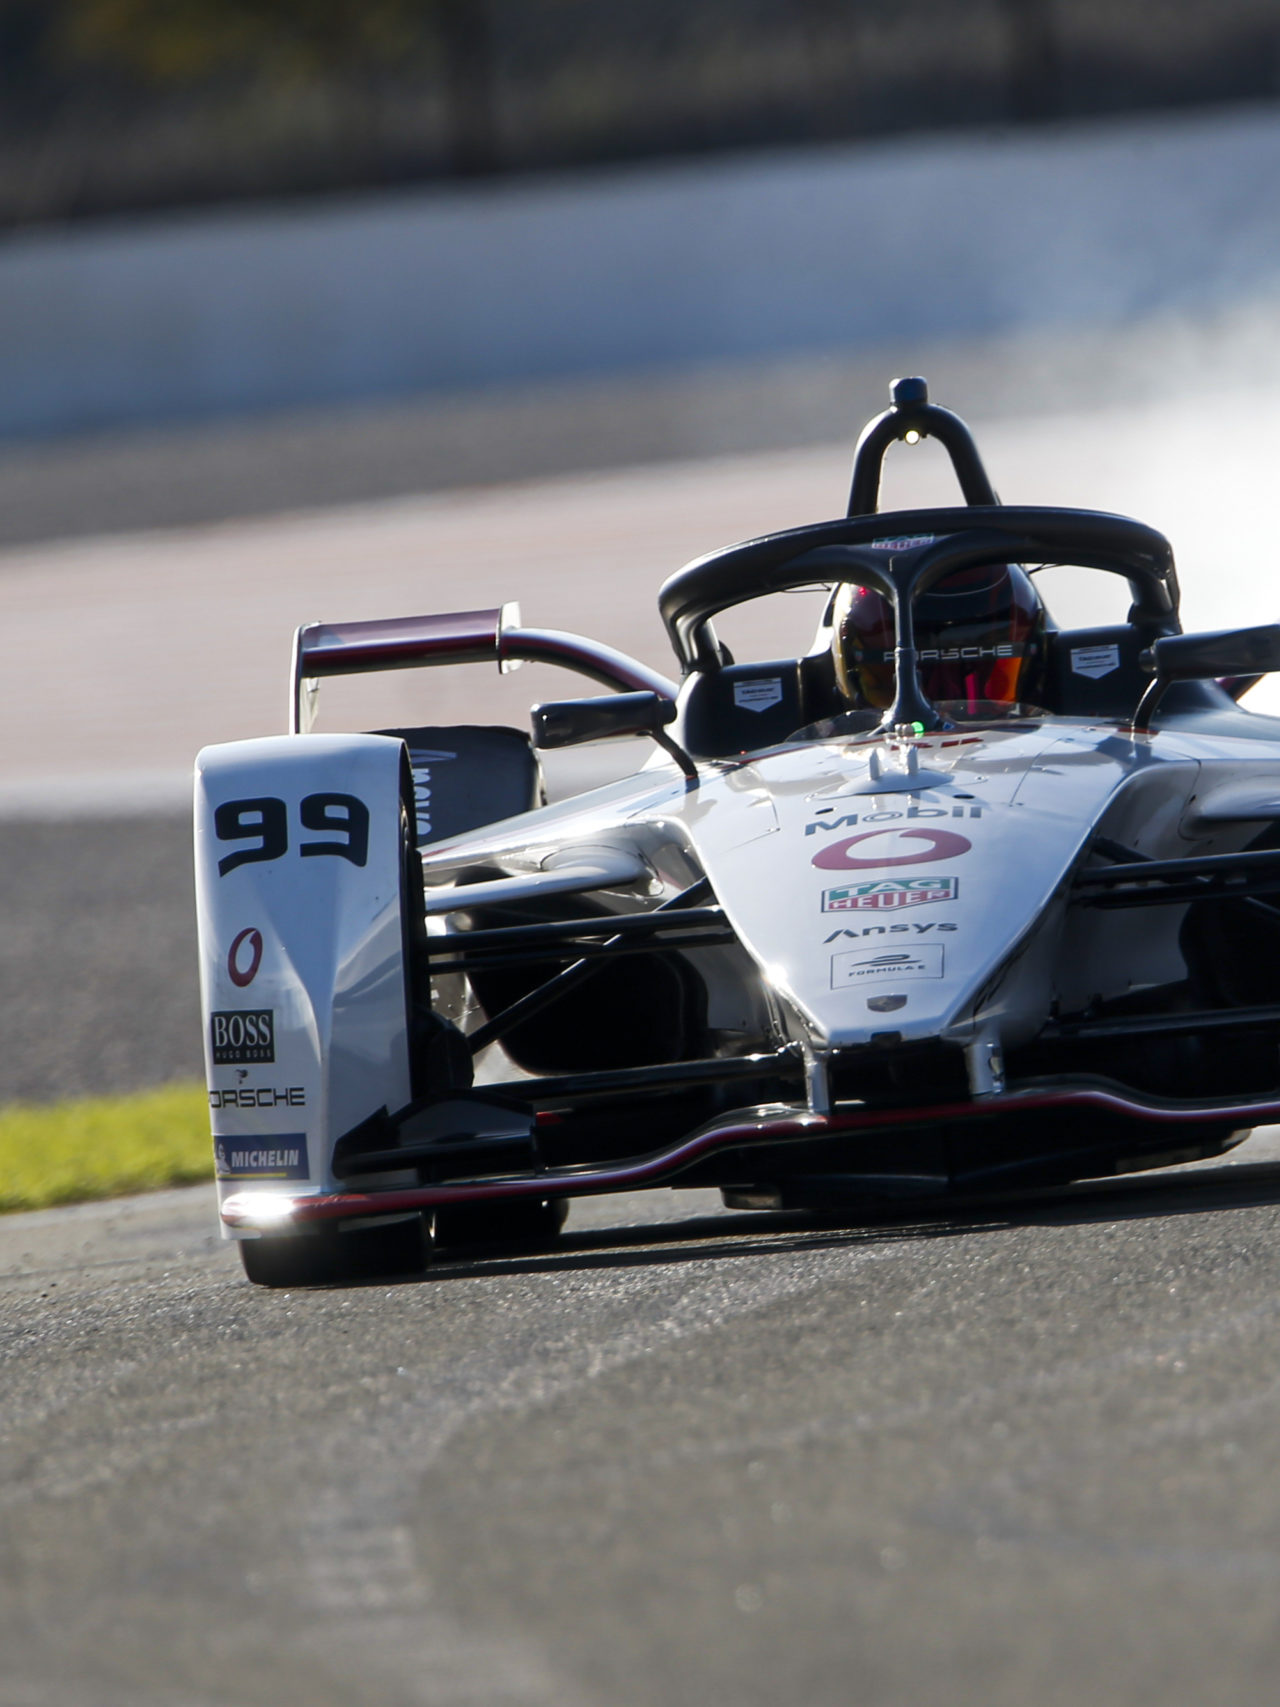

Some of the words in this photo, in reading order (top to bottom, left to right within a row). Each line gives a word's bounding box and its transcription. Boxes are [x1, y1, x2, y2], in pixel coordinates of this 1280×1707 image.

[884, 645, 1013, 662] PRSCHE
[804, 806, 982, 836] Mobil
[214, 793, 370, 878] 99
[834, 879, 943, 896] TAG
[830, 890, 950, 909] HEUER
[823, 923, 959, 943] Ansys
[848, 965, 915, 977] FORMULA
[214, 1014, 271, 1047] BOSS
[215, 1050, 241, 1059] HUGO
[209, 1087, 306, 1109] ORSCHE
[231, 1149, 300, 1168] MICHELIN
